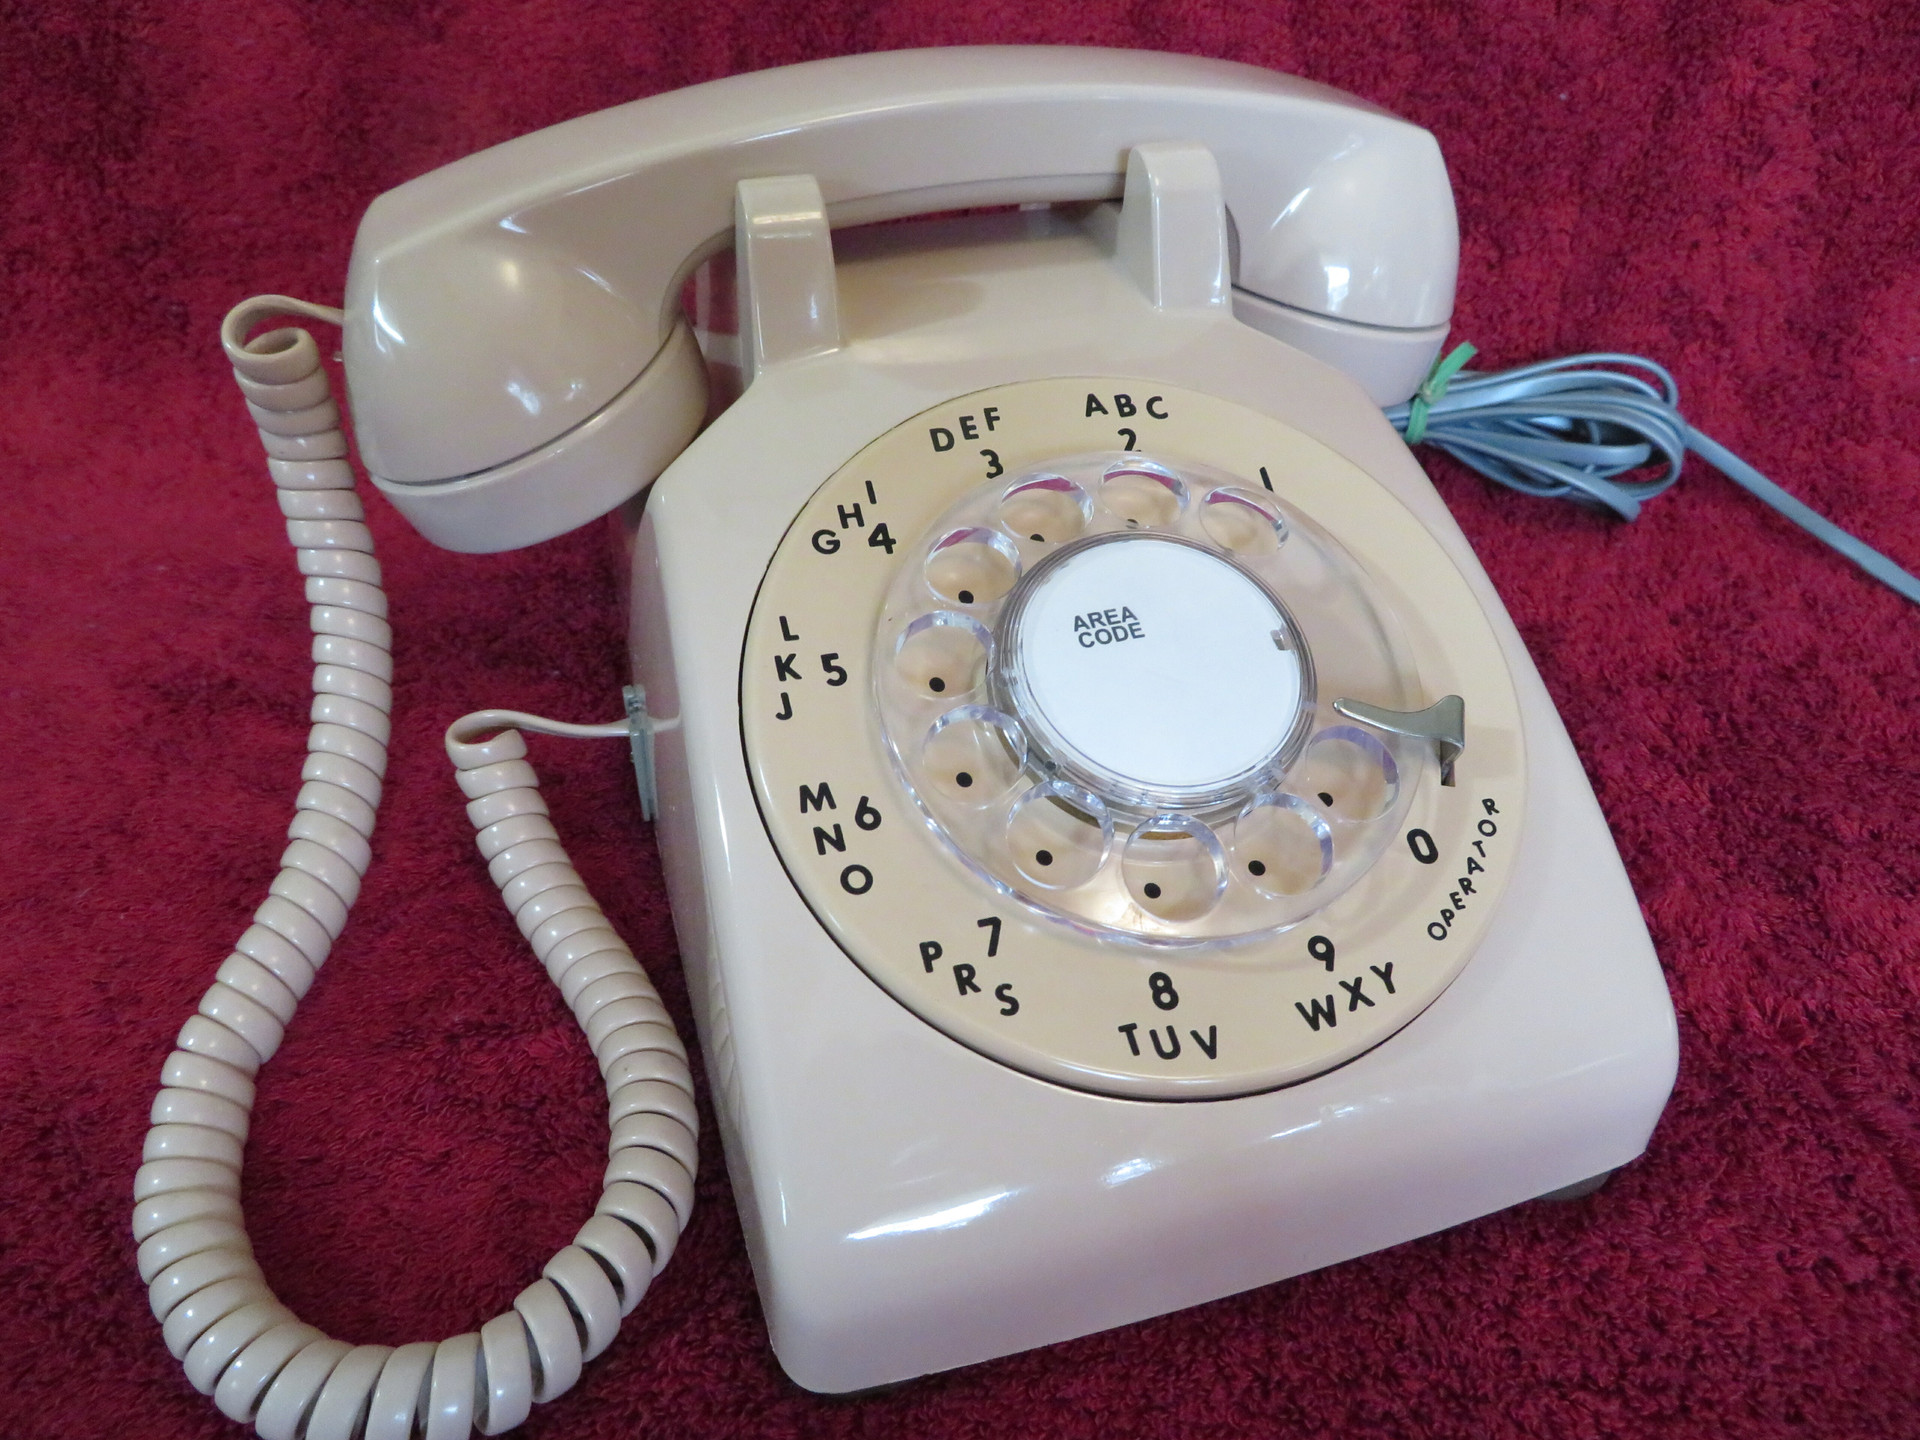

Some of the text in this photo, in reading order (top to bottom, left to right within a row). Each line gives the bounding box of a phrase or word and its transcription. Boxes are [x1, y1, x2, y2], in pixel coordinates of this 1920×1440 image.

[1085, 393, 1169, 420] ABC
[929, 407, 1001, 452] DEF
[1117, 428, 1141, 453] 2
[980, 449, 1004, 479] 3
[868, 522, 897, 554] 4
[1073, 606, 1139, 632] AREA
[1078, 622, 1145, 648] CODE
[820, 652, 848, 686] 5
[854, 795, 882, 831] 6
[1427, 798, 1500, 941] OPERATOR
[977, 916, 1002, 957] 7
[1307, 935, 1335, 972] 9
[919, 940, 1020, 1017] PRS
[1148, 971, 1179, 1011] 8
[1295, 961, 1396, 1031] WXY
[1118, 1023, 1217, 1060] TUV
